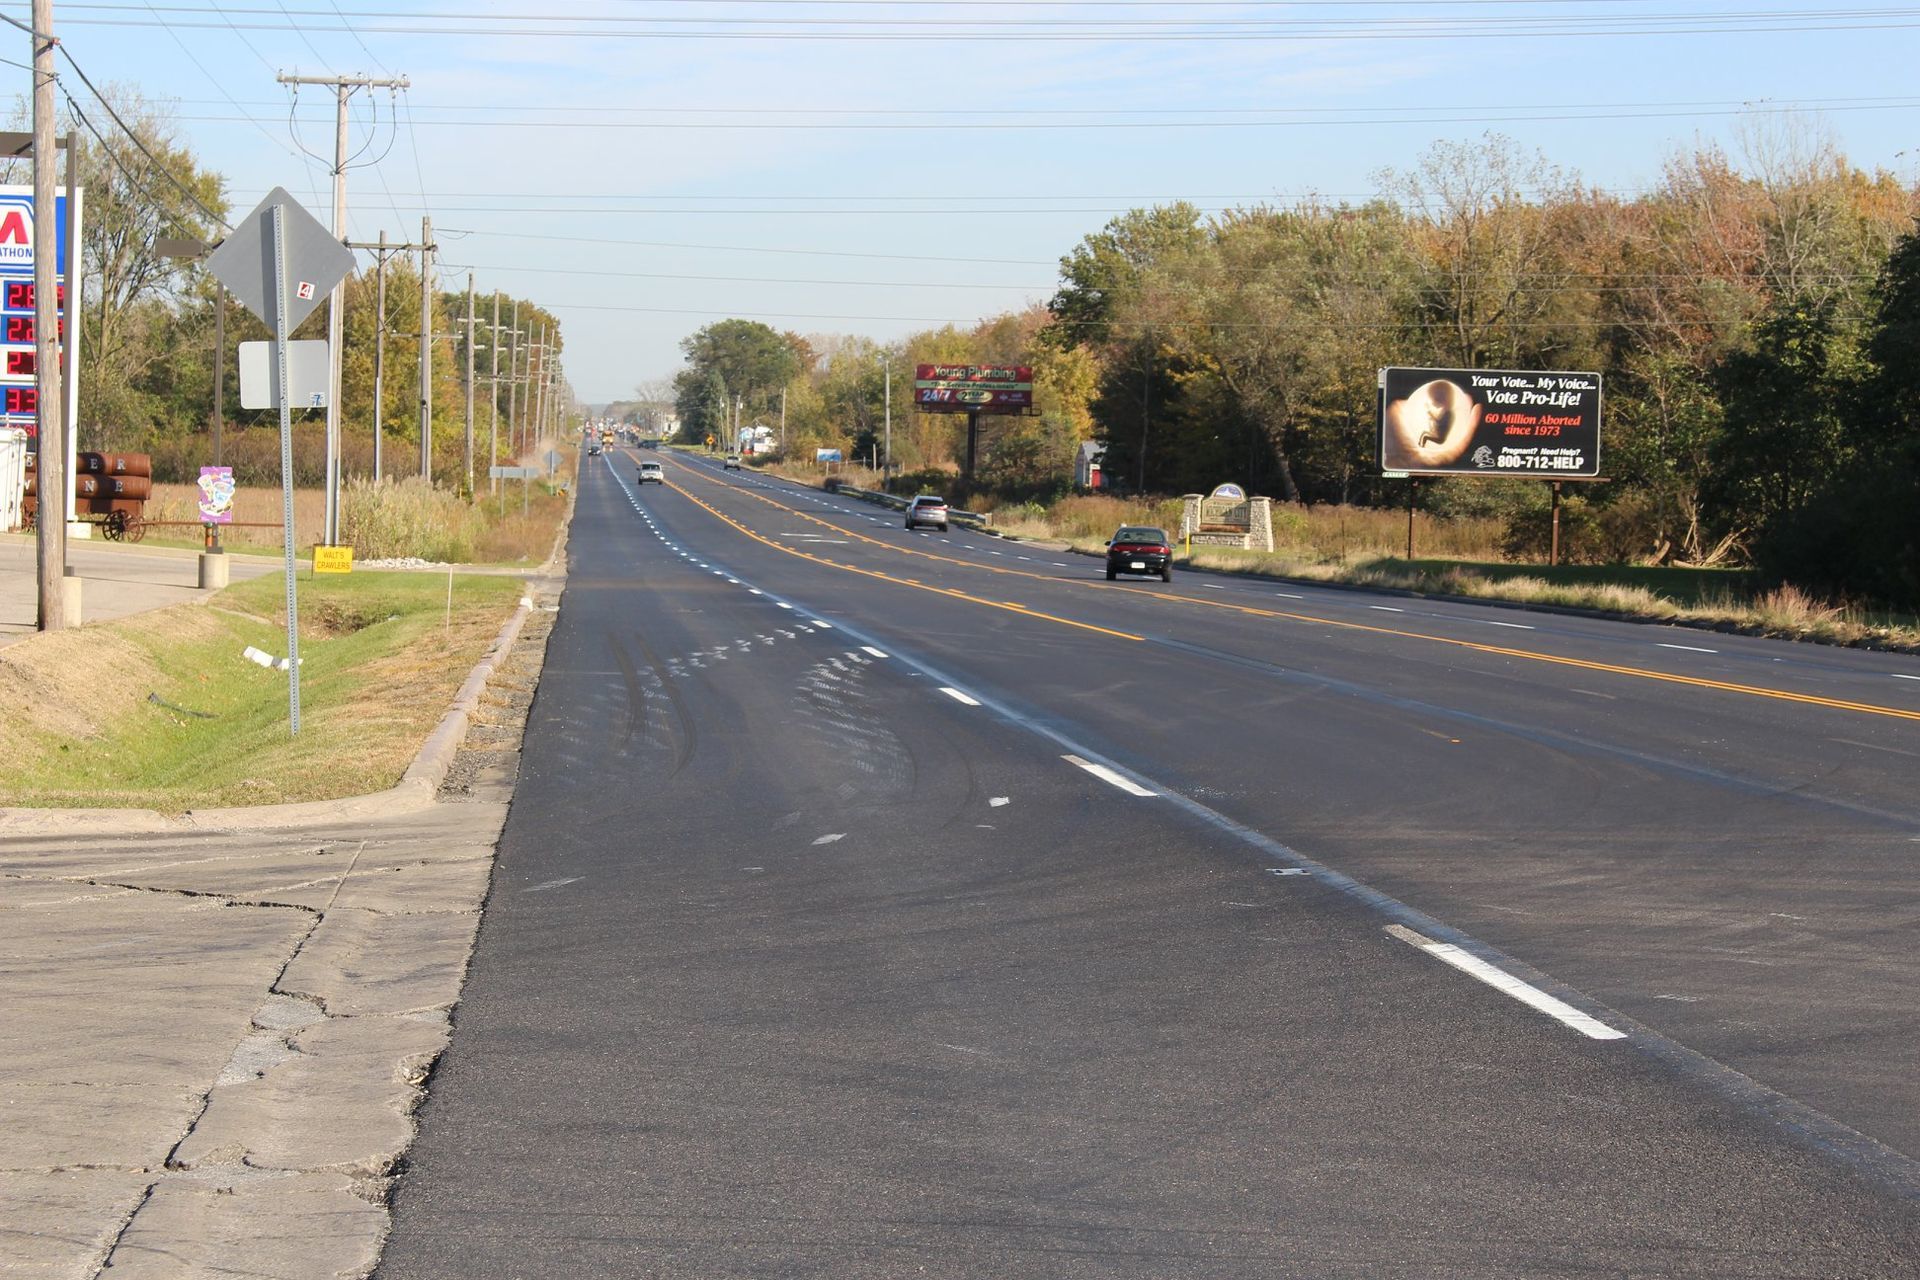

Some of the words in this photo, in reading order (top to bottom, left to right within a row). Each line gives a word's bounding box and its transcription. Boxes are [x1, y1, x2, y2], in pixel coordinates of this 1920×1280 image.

[934, 366, 966, 379] Young
[968, 366, 1016, 380] Plumbing
[1471, 375, 1500, 387] Your
[1501, 376, 1535, 388] Vote...
[1537, 377, 1556, 390] My
[1558, 378, 1596, 390] Voice...
[922, 389, 951, 401] 24/7
[1486, 390, 1519, 404] Vote
[1521, 391, 1581, 408] Pro-Life!
[1485, 413, 1499, 424] 60
[1501, 413, 1537, 425] Million
[1538, 415, 1581, 426] Aborted
[1504, 425, 1531, 435] since
[1534, 426, 1560, 436] 1973
[1501, 446, 1538, 455] Pregnant?
[1540, 448, 1560, 456] Need
[1560, 448, 1581, 457] Help?
[1497, 455, 1584, 469] 800-712-HELP
